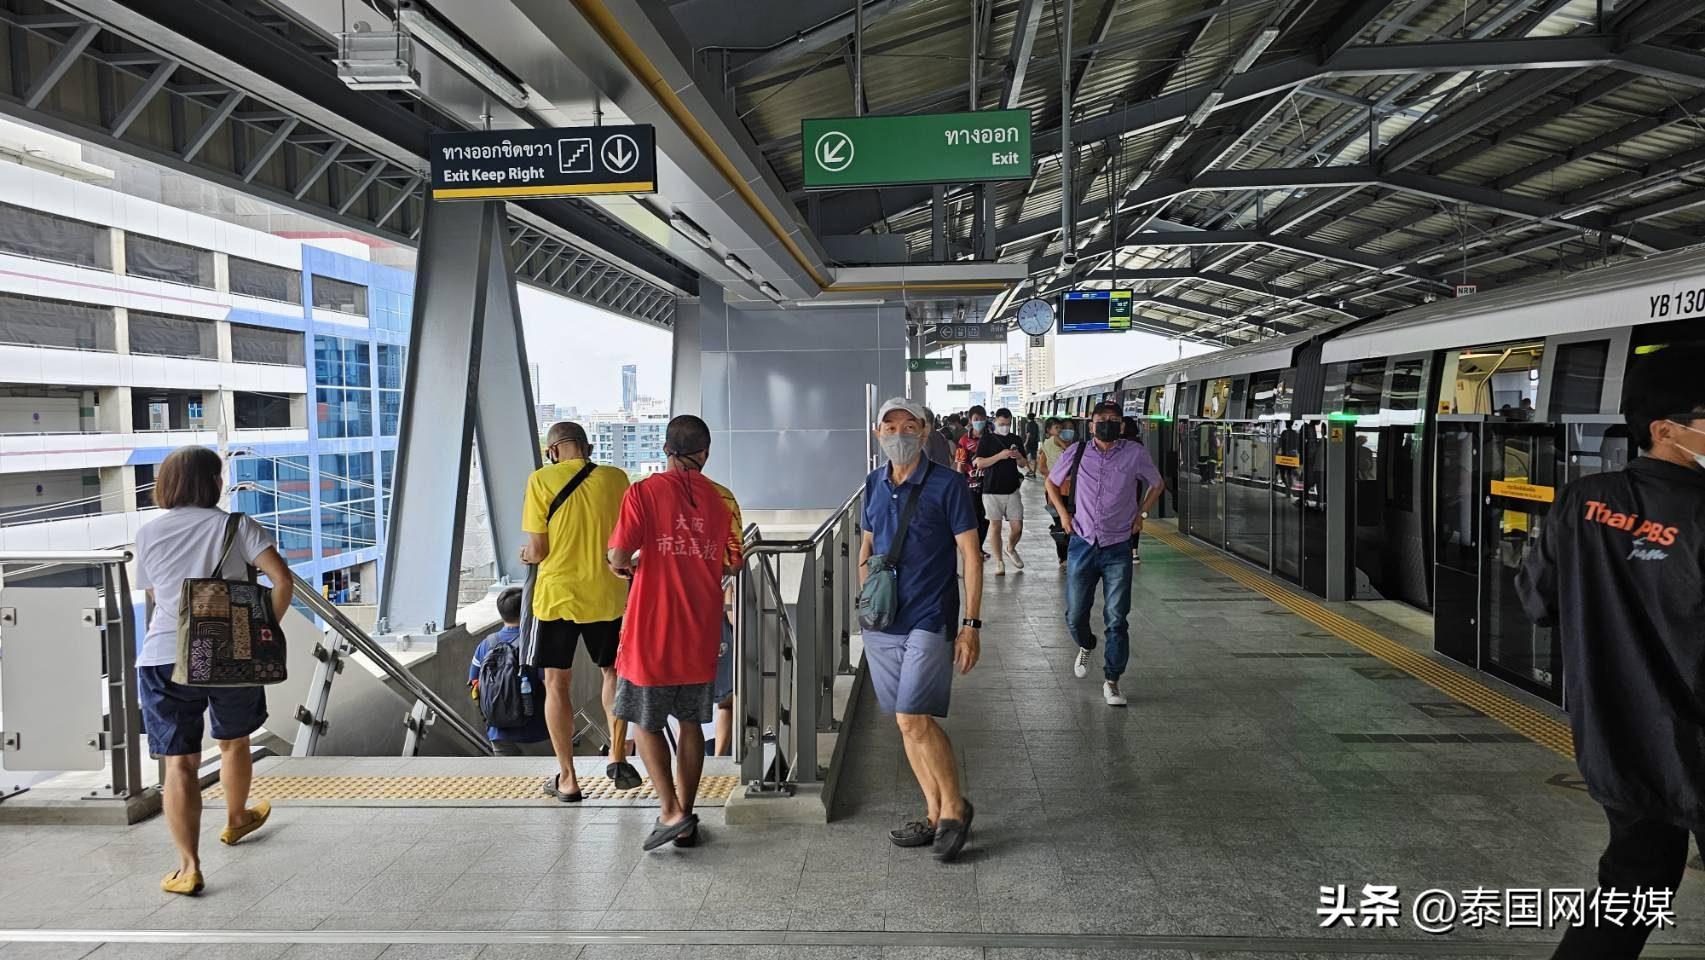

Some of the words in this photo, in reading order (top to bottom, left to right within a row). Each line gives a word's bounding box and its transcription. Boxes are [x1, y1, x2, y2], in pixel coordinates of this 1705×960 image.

[945, 127, 1019, 145] ทางออก
[442, 140, 553, 160] ทางออกชิดขวา
[992, 152, 1019, 165] Exit
[443, 169, 469, 182] Exit
[472, 168, 506, 183] Keep
[508, 167, 545, 182] Right
[1458, 287, 1475, 295] NRM
[1650, 294, 1670, 318] YB
[1675, 288, 1705, 315] 130
[675, 514, 705, 534] 大阪
[1584, 500, 1639, 531] Thai
[1632, 520, 1679, 546] PBS
[656, 534, 718, 561] 市立高校
